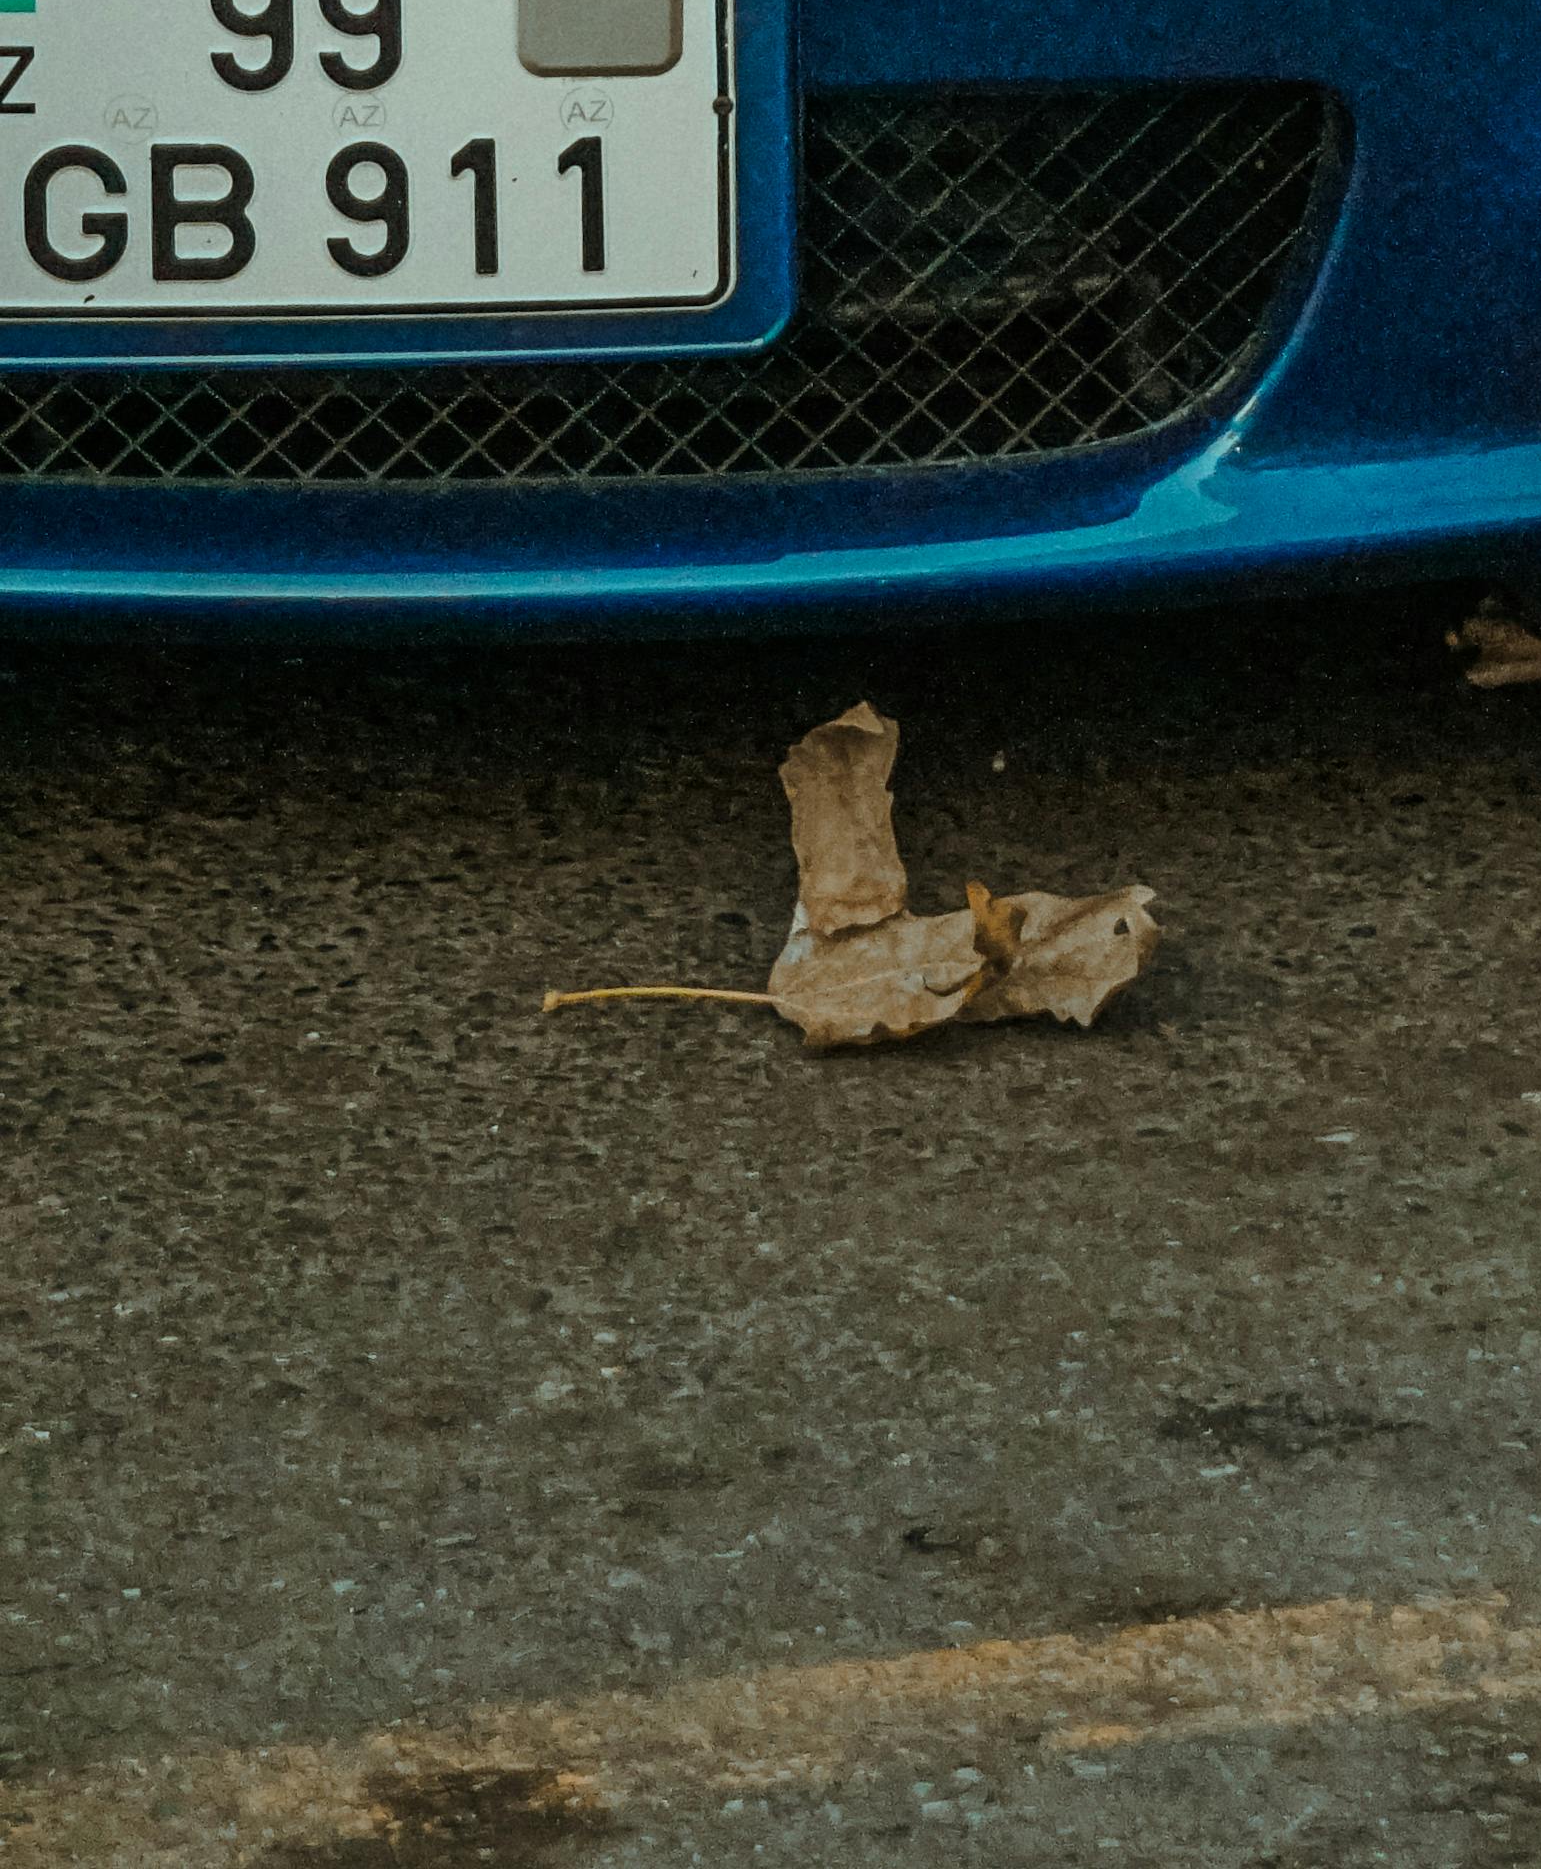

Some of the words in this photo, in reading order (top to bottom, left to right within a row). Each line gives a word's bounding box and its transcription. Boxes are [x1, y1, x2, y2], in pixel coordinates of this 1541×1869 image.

[111, 107, 153, 129] AZ
[339, 105, 380, 128] AZ
[567, 100, 608, 123] AZ
[23, 144, 256, 282] GB
[325, 136, 605, 278] 911
